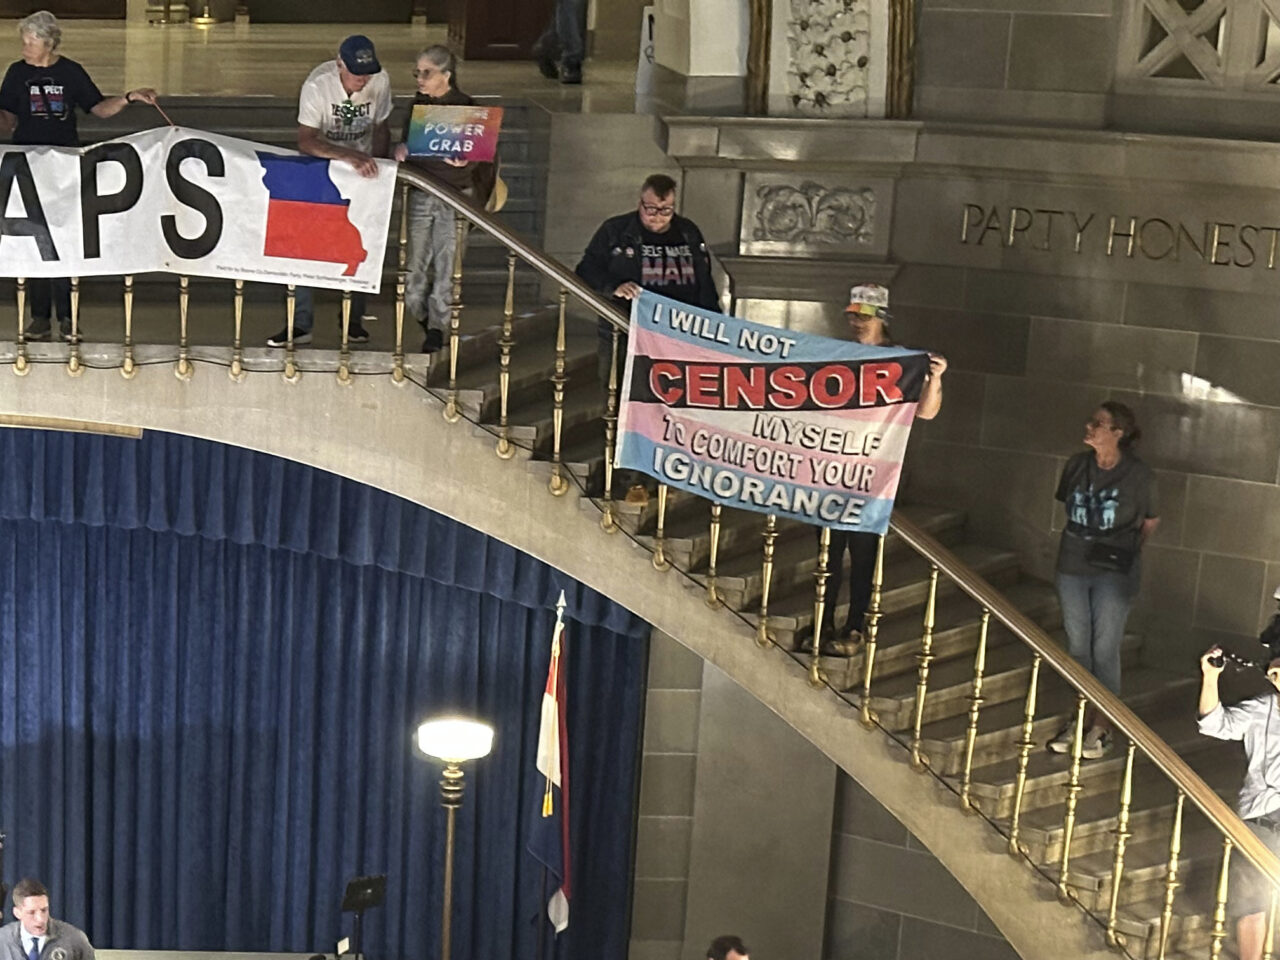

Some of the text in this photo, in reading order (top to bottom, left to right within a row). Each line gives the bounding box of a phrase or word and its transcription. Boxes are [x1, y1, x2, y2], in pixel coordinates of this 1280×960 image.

[424, 122, 485, 136] POWER
[428, 139, 475, 152] GRAB
[960, 203, 1280, 269] PARTY HONEST
[642, 257, 696, 286] MAN
[653, 303, 796, 358] I WILL NOT
[649, 361, 904, 410] CENSOR
[663, 414, 876, 492] TO COMFORT YOUR
[752, 413, 882, 457] MYSELF
[653, 446, 866, 525] IGNORANCE
